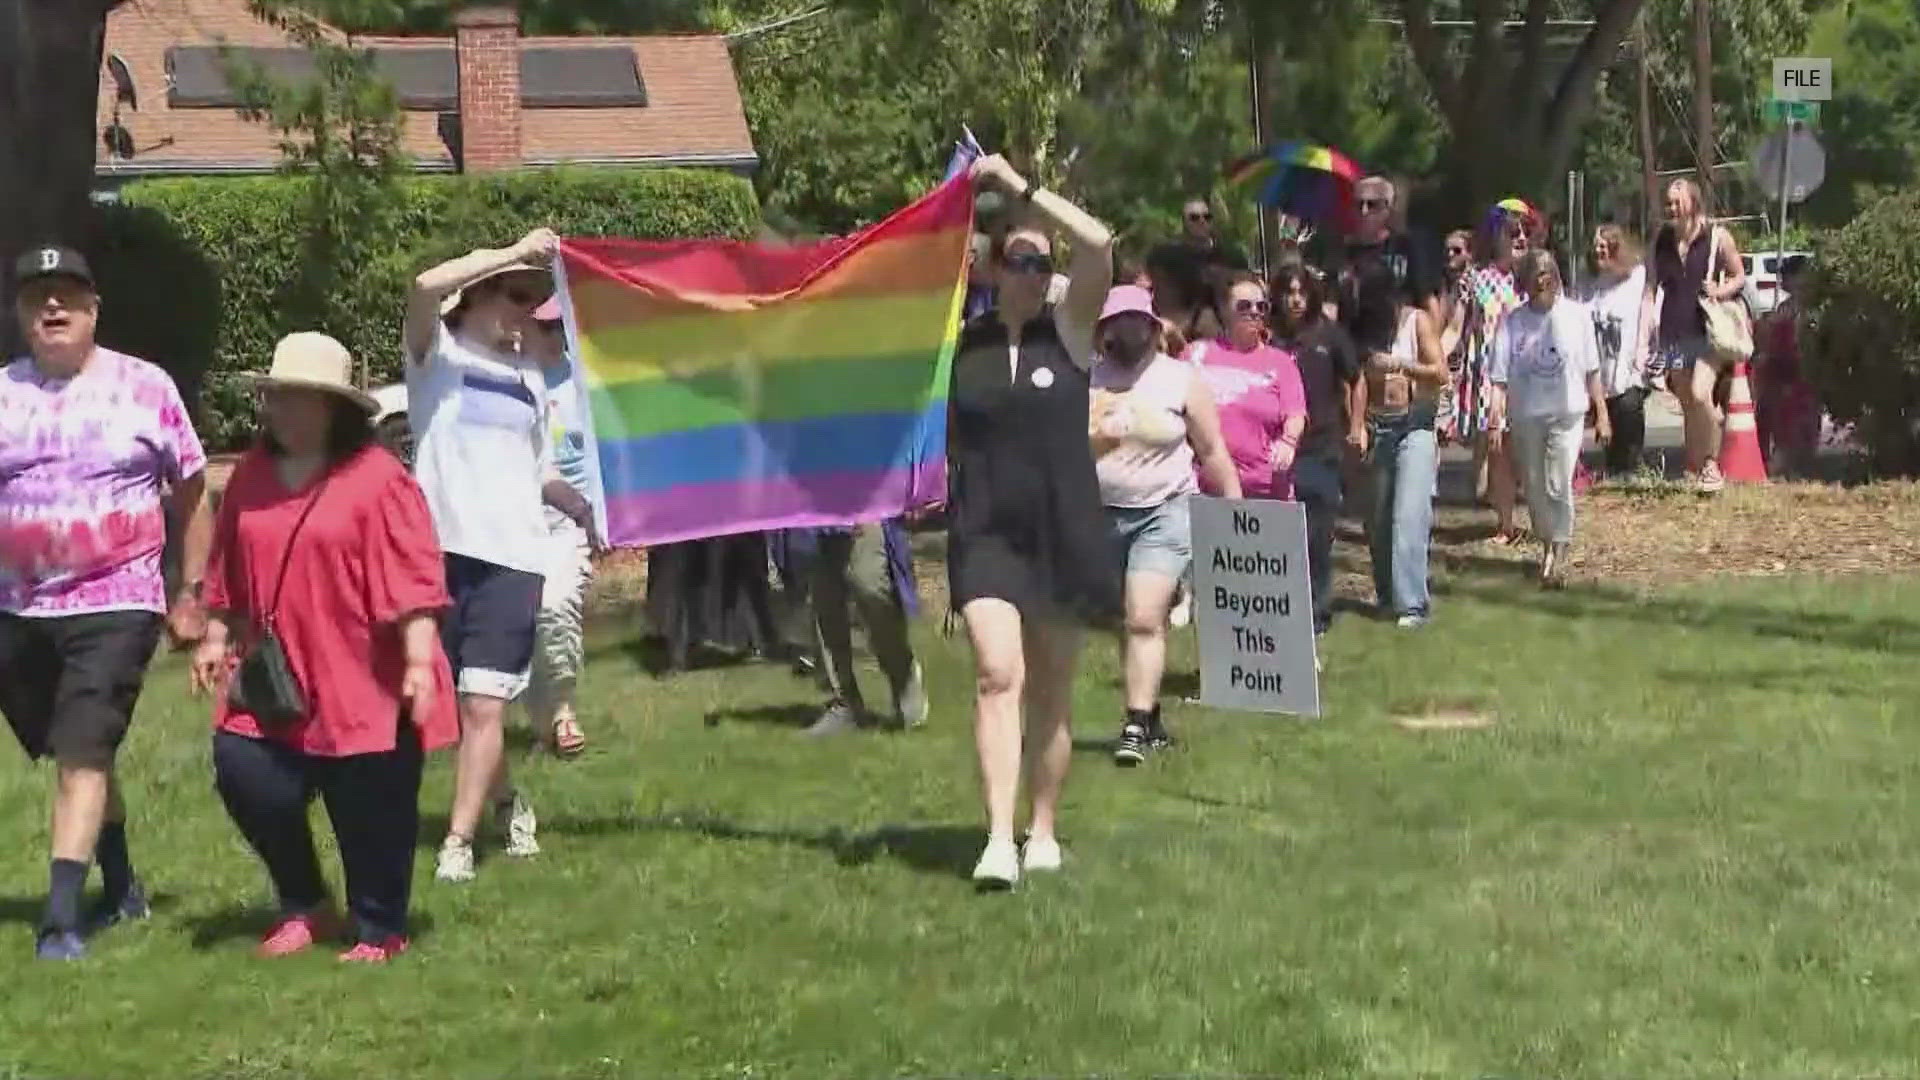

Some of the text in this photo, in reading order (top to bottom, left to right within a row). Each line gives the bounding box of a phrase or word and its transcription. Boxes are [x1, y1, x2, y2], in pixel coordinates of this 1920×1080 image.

[40, 249, 60, 270] D
[1232, 509, 1261, 537] No
[1211, 546, 1288, 577] Alcohol
[1214, 585, 1291, 618] Beyond
[1232, 625, 1276, 654] This
[1230, 664, 1283, 695] Point
